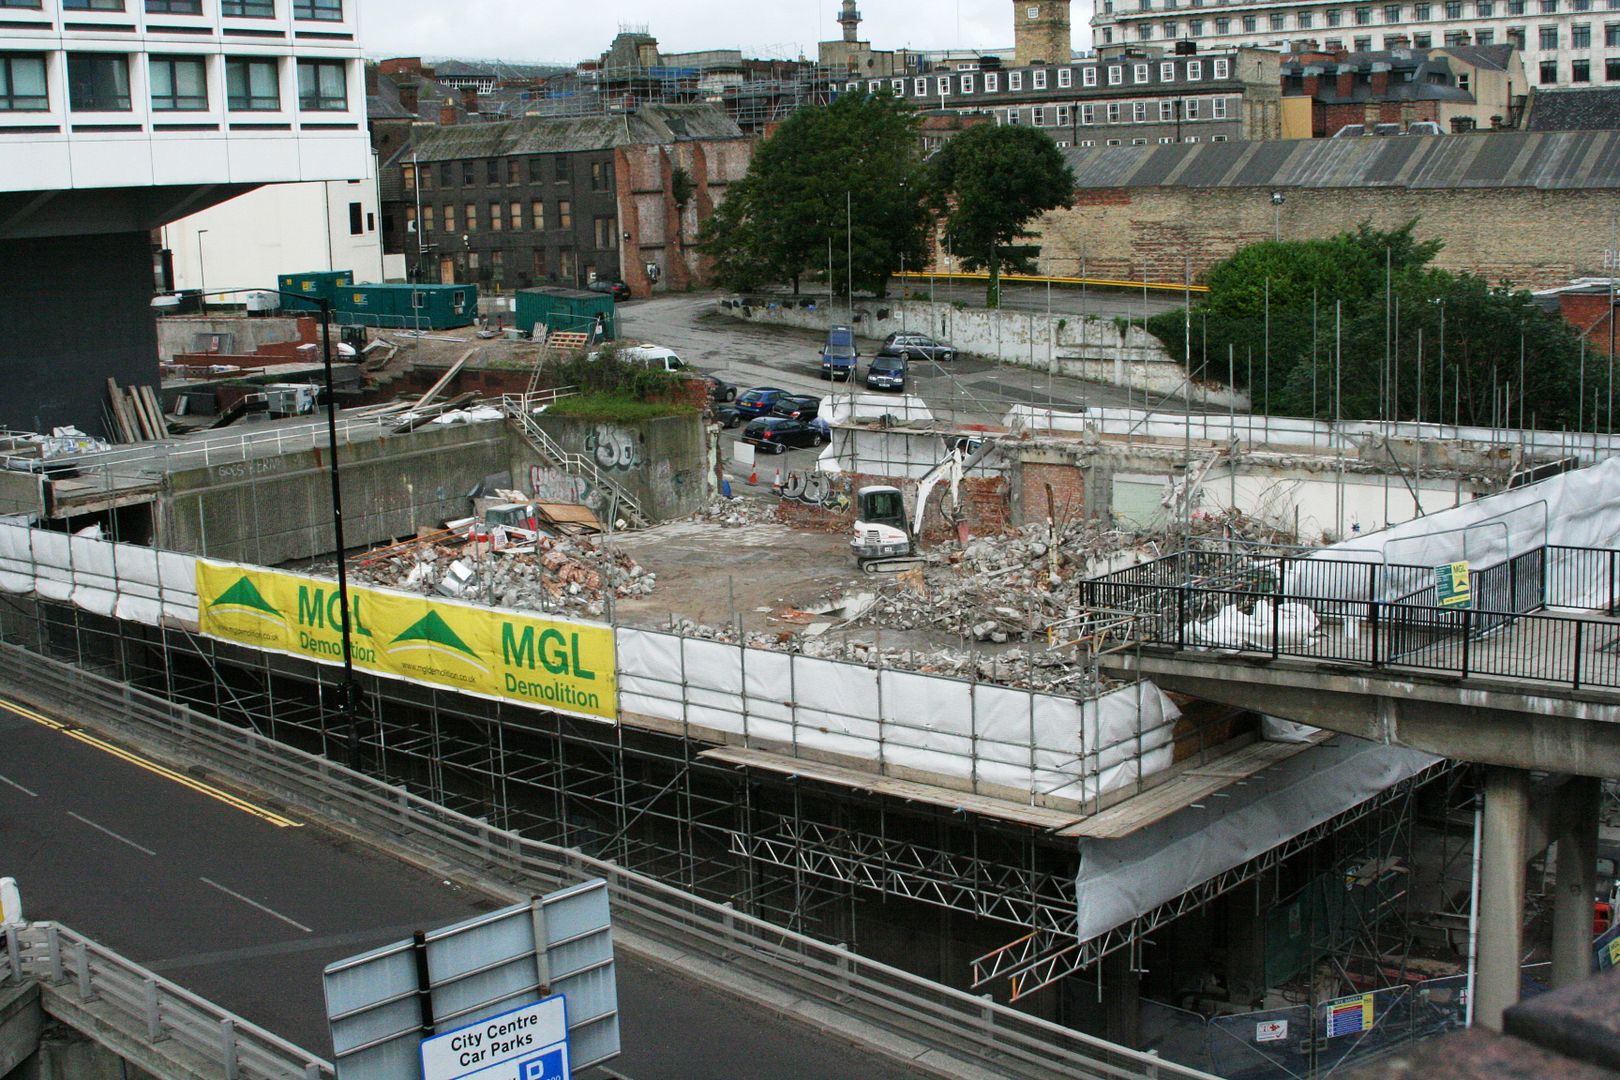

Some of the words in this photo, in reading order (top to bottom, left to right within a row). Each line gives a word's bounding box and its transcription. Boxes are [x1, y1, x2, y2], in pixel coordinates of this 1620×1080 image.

[299, 585, 372, 637] MGL
[502, 621, 595, 681] MGL
[505, 672, 599, 709] Demolition
[451, 1032, 482, 1051] City
[487, 1014, 538, 1039] Centre
[459, 1049, 486, 1067] Car
[491, 1033, 534, 1056] Parks
